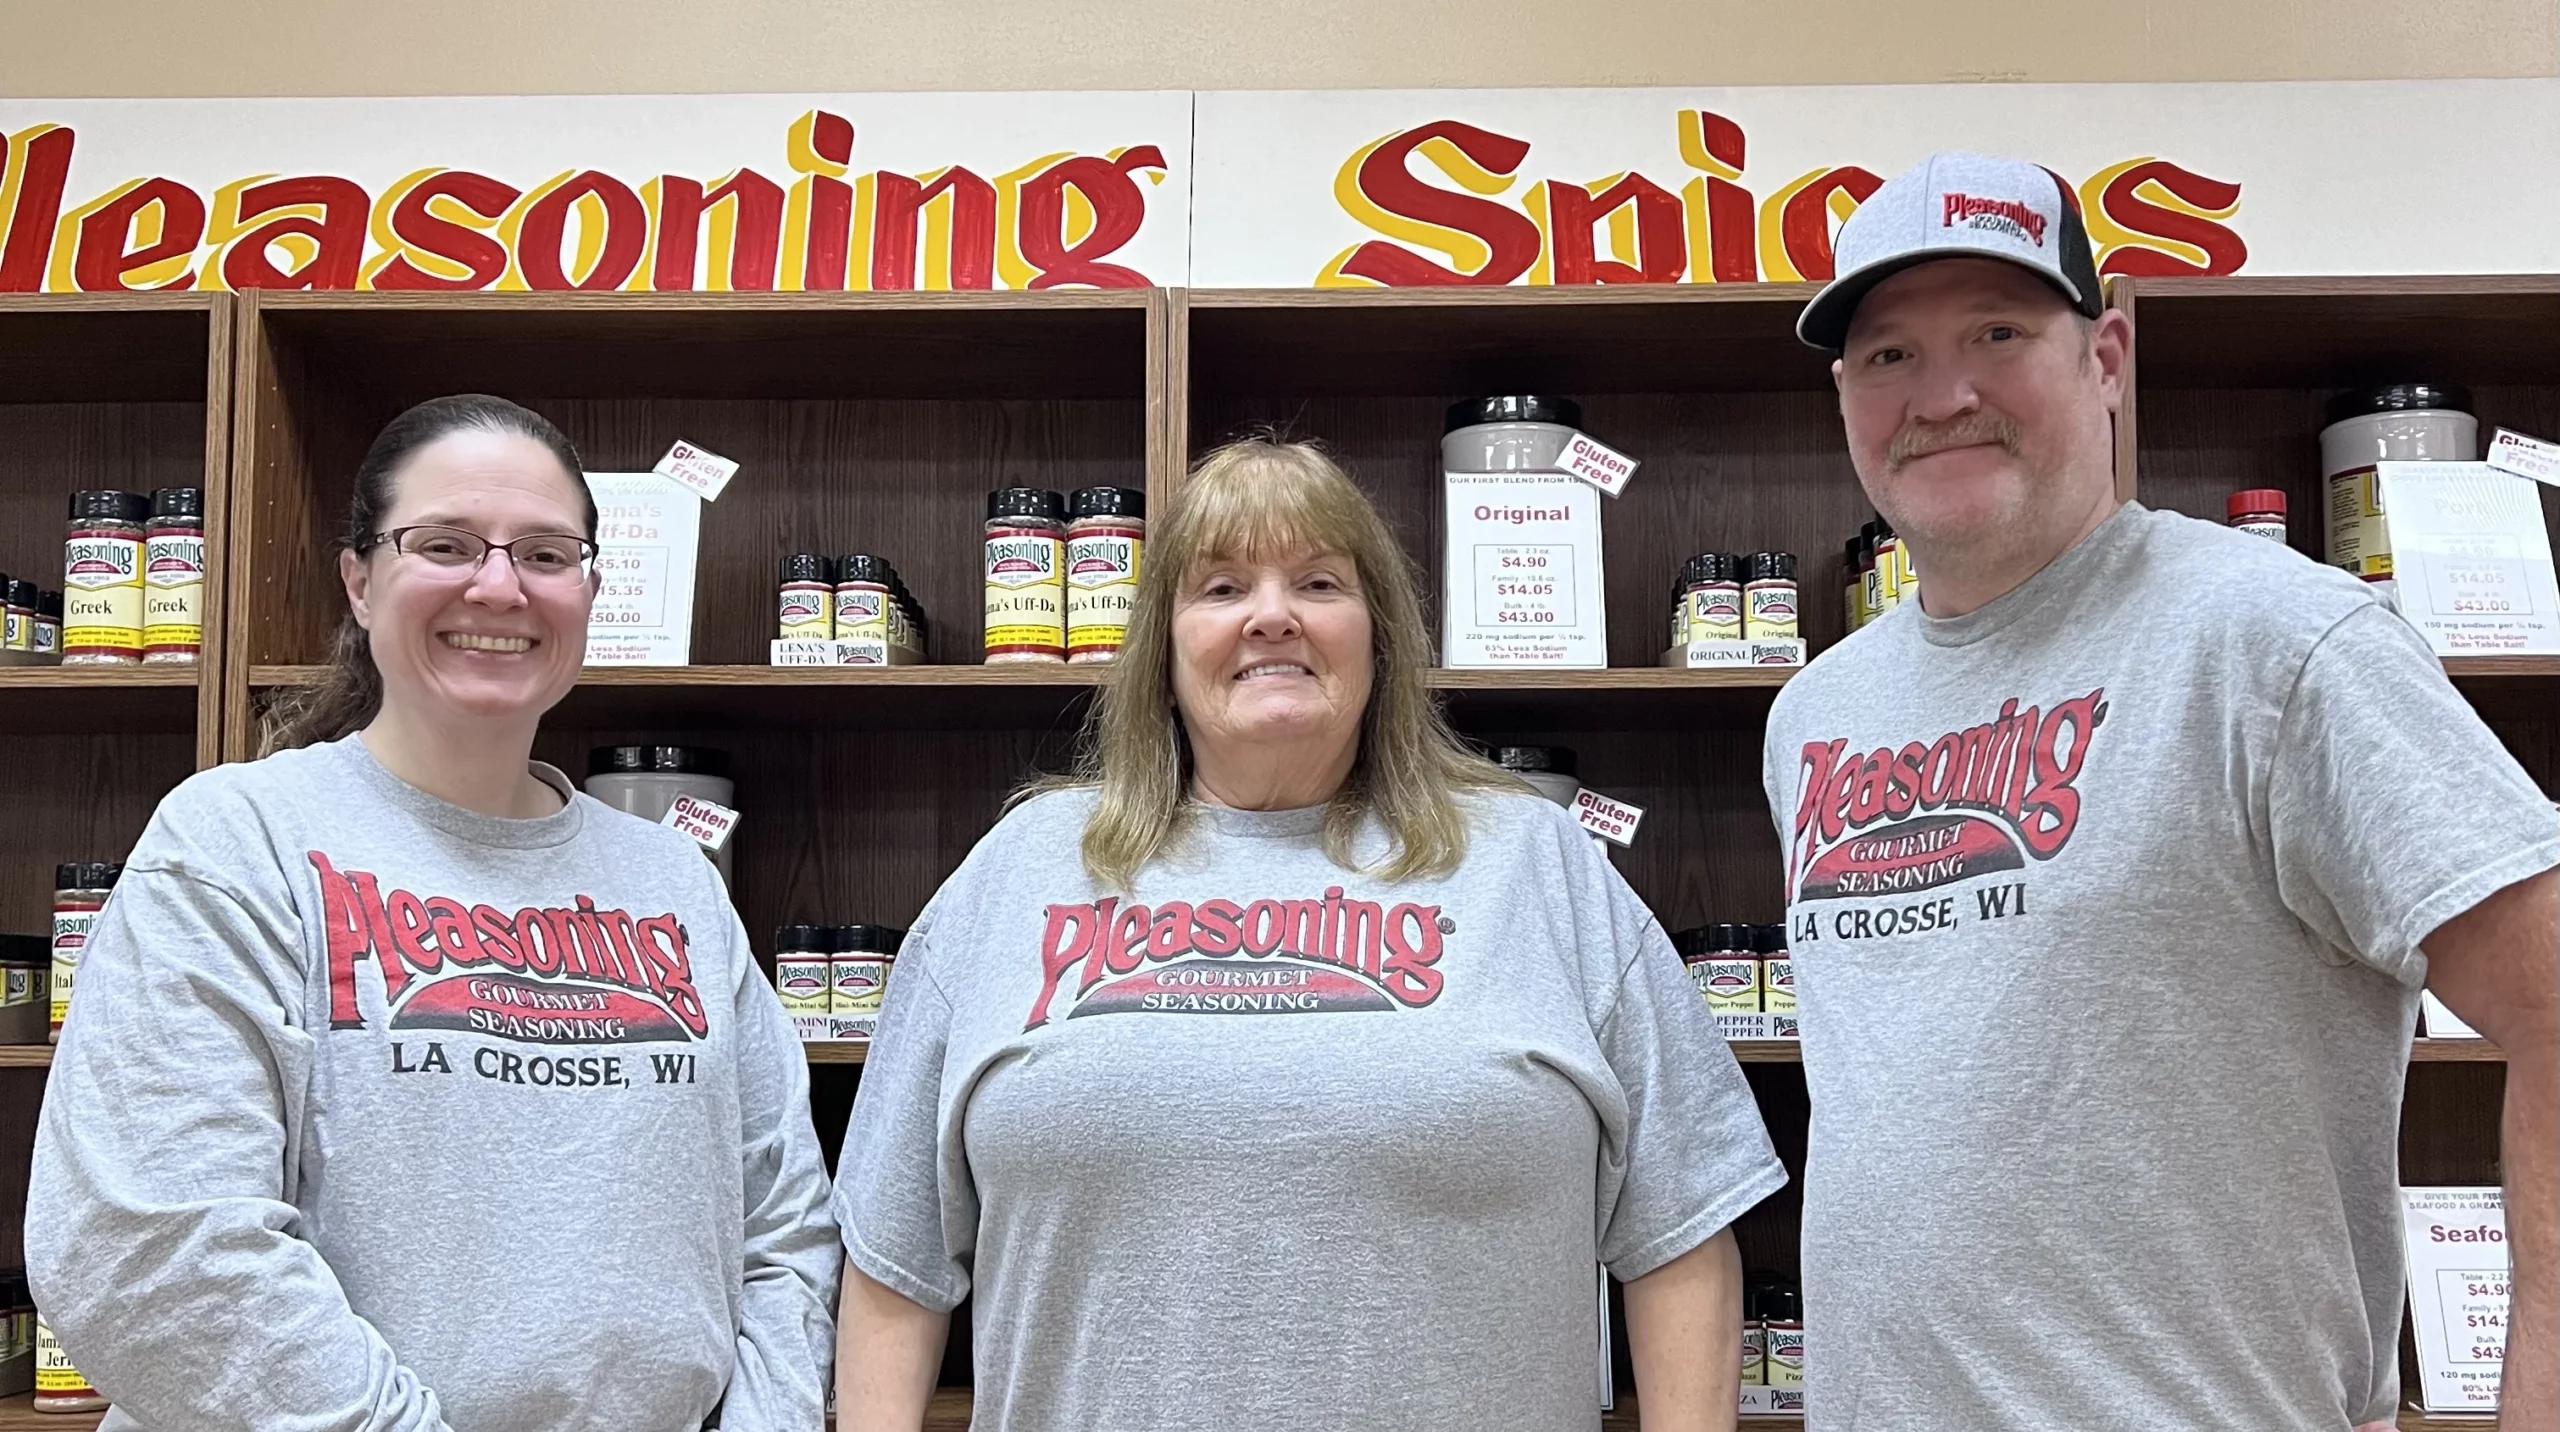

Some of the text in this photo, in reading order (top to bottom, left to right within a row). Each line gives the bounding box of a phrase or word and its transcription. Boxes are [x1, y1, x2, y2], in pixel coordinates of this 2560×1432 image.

[0, 109, 2247, 291] leasoning Spics
[1942, 193, 2047, 247] Pleasoning
[672, 446, 725, 479] Gluten
[1573, 440, 1628, 475] Gluten
[2505, 451, 2549, 475] Free
[670, 463, 708, 489] Free
[1572, 456, 1612, 485] Free
[600, 503, 662, 518] ena's
[1474, 505, 1570, 524] Original
[601, 524, 658, 539] ff-Da
[595, 559, 640, 570] $5.10
[1502, 556, 1547, 568] $4.90
[601, 585, 643, 596] 15.35
[1497, 584, 1553, 595] $14.05
[70, 599, 112, 615] Greek
[148, 597, 188, 614] Greek
[1013, 597, 1055, 613] Uff-Da
[2454, 600, 2510, 611] $43.00
[1498, 611, 1554, 622] $43.00
[780, 643, 883, 665] LENA'S Pleasoning
[780, 655, 825, 665] UFF-DA
[1690, 644, 1798, 665] ORIGINAL Pleasoning
[1787, 687, 2105, 908] Pleasoning
[675, 797, 729, 830] Gluten
[1577, 792, 1636, 826] Gluten
[673, 815, 713, 841] Free
[1579, 809, 1622, 836] Free
[1850, 822, 1967, 863] GOURMET
[1836, 852, 1965, 894] SEASONING
[1795, 883, 2027, 943] LA CROSSE, WI
[307, 850, 708, 1040] Pleasoning
[55, 973, 73, 988] Ital
[780, 964, 827, 988] Pleasoning
[833, 963, 881, 987] Pleasoning
[1155, 969, 1314, 988] GOURMET
[469, 980, 611, 1012] GOURMET
[1142, 991, 1320, 1011] SEASONING
[1774, 1001, 1796, 1009] Peppe
[469, 1009, 626, 1041] SEASONING
[1716, 1016, 1764, 1026] PEPPER
[390, 1042, 696, 1090] LA CROSSE, WI
[2424, 1192, 2449, 1200] GIVE
[2452, 1192, 2479, 1200] YOUR
[2430, 1225, 2503, 1242] Seafo
[2462, 1304, 2491, 1313] Family
[2471, 1346, 2503, 1359] $43
[1785, 1373, 1803, 1381] Pizz
